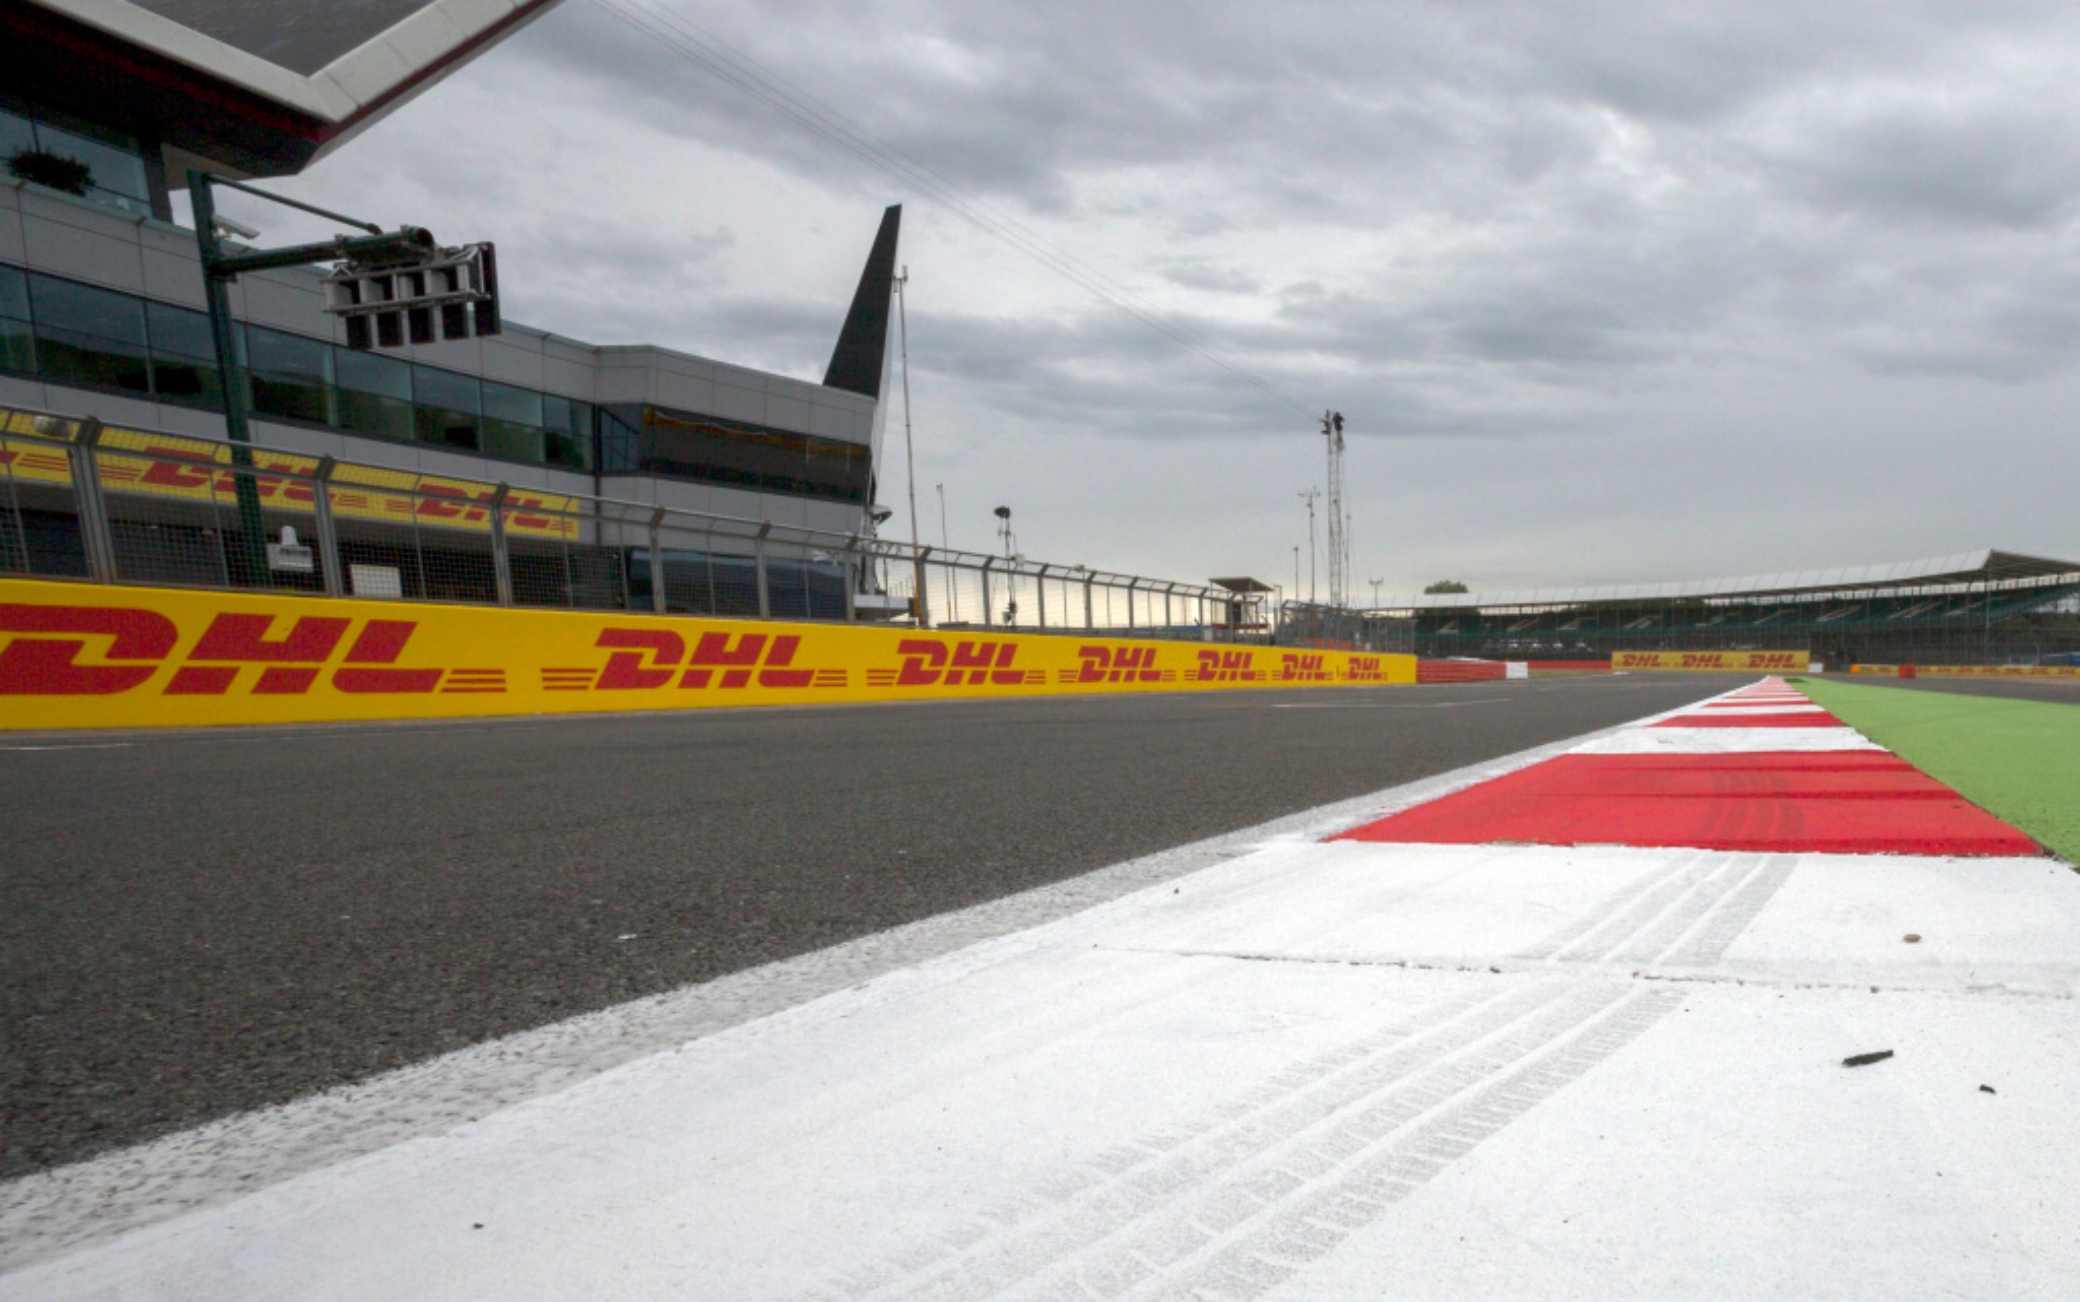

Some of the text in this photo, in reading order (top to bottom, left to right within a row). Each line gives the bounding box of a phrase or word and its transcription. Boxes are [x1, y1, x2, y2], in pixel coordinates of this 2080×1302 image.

[416, 484, 550, 528] DHL
[0, 603, 443, 695] DHL
[596, 628, 814, 689] DHL
[898, 639, 1025, 685] DHL
[1079, 646, 1162, 682] DHL
[1198, 650, 1256, 680] DHL
[1282, 654, 1326, 680] DHL
[1748, 654, 1796, 668] DHL
[1348, 657, 1382, 679] DHL
